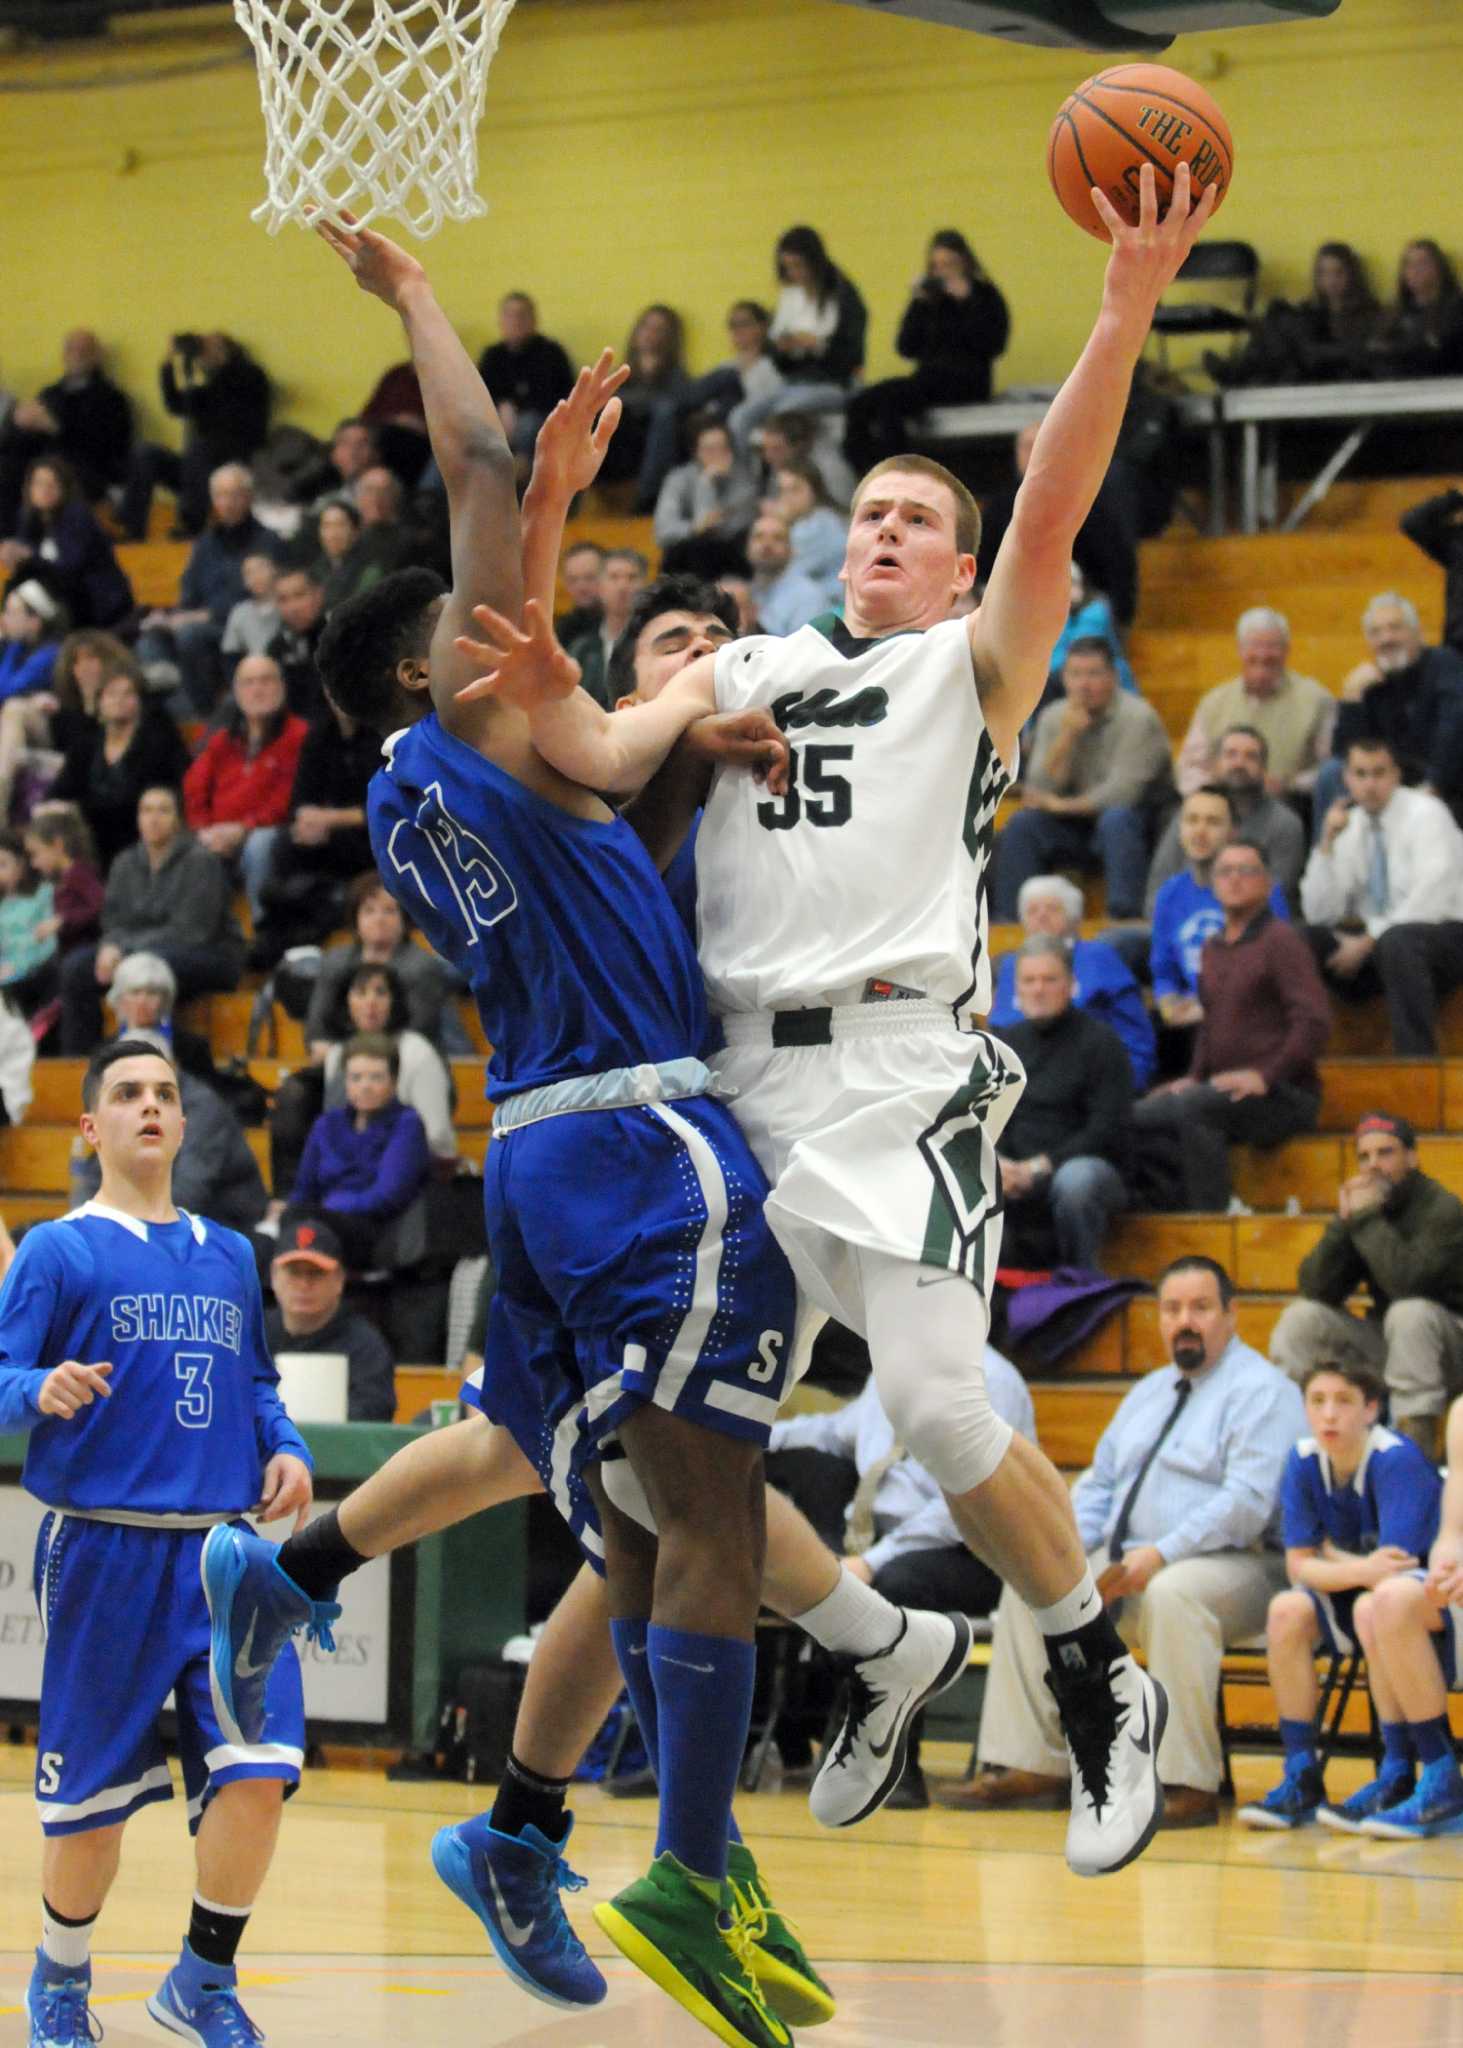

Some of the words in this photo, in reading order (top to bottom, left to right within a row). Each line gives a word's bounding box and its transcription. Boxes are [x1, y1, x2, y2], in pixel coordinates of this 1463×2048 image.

[1137, 105, 1192, 156] THE
[757, 744, 854, 831] 35
[110, 1294, 243, 1356] SHAKER
[746, 1328, 784, 1384] S
[173, 1352, 213, 1429] 3
[38, 1752, 64, 1795] S
